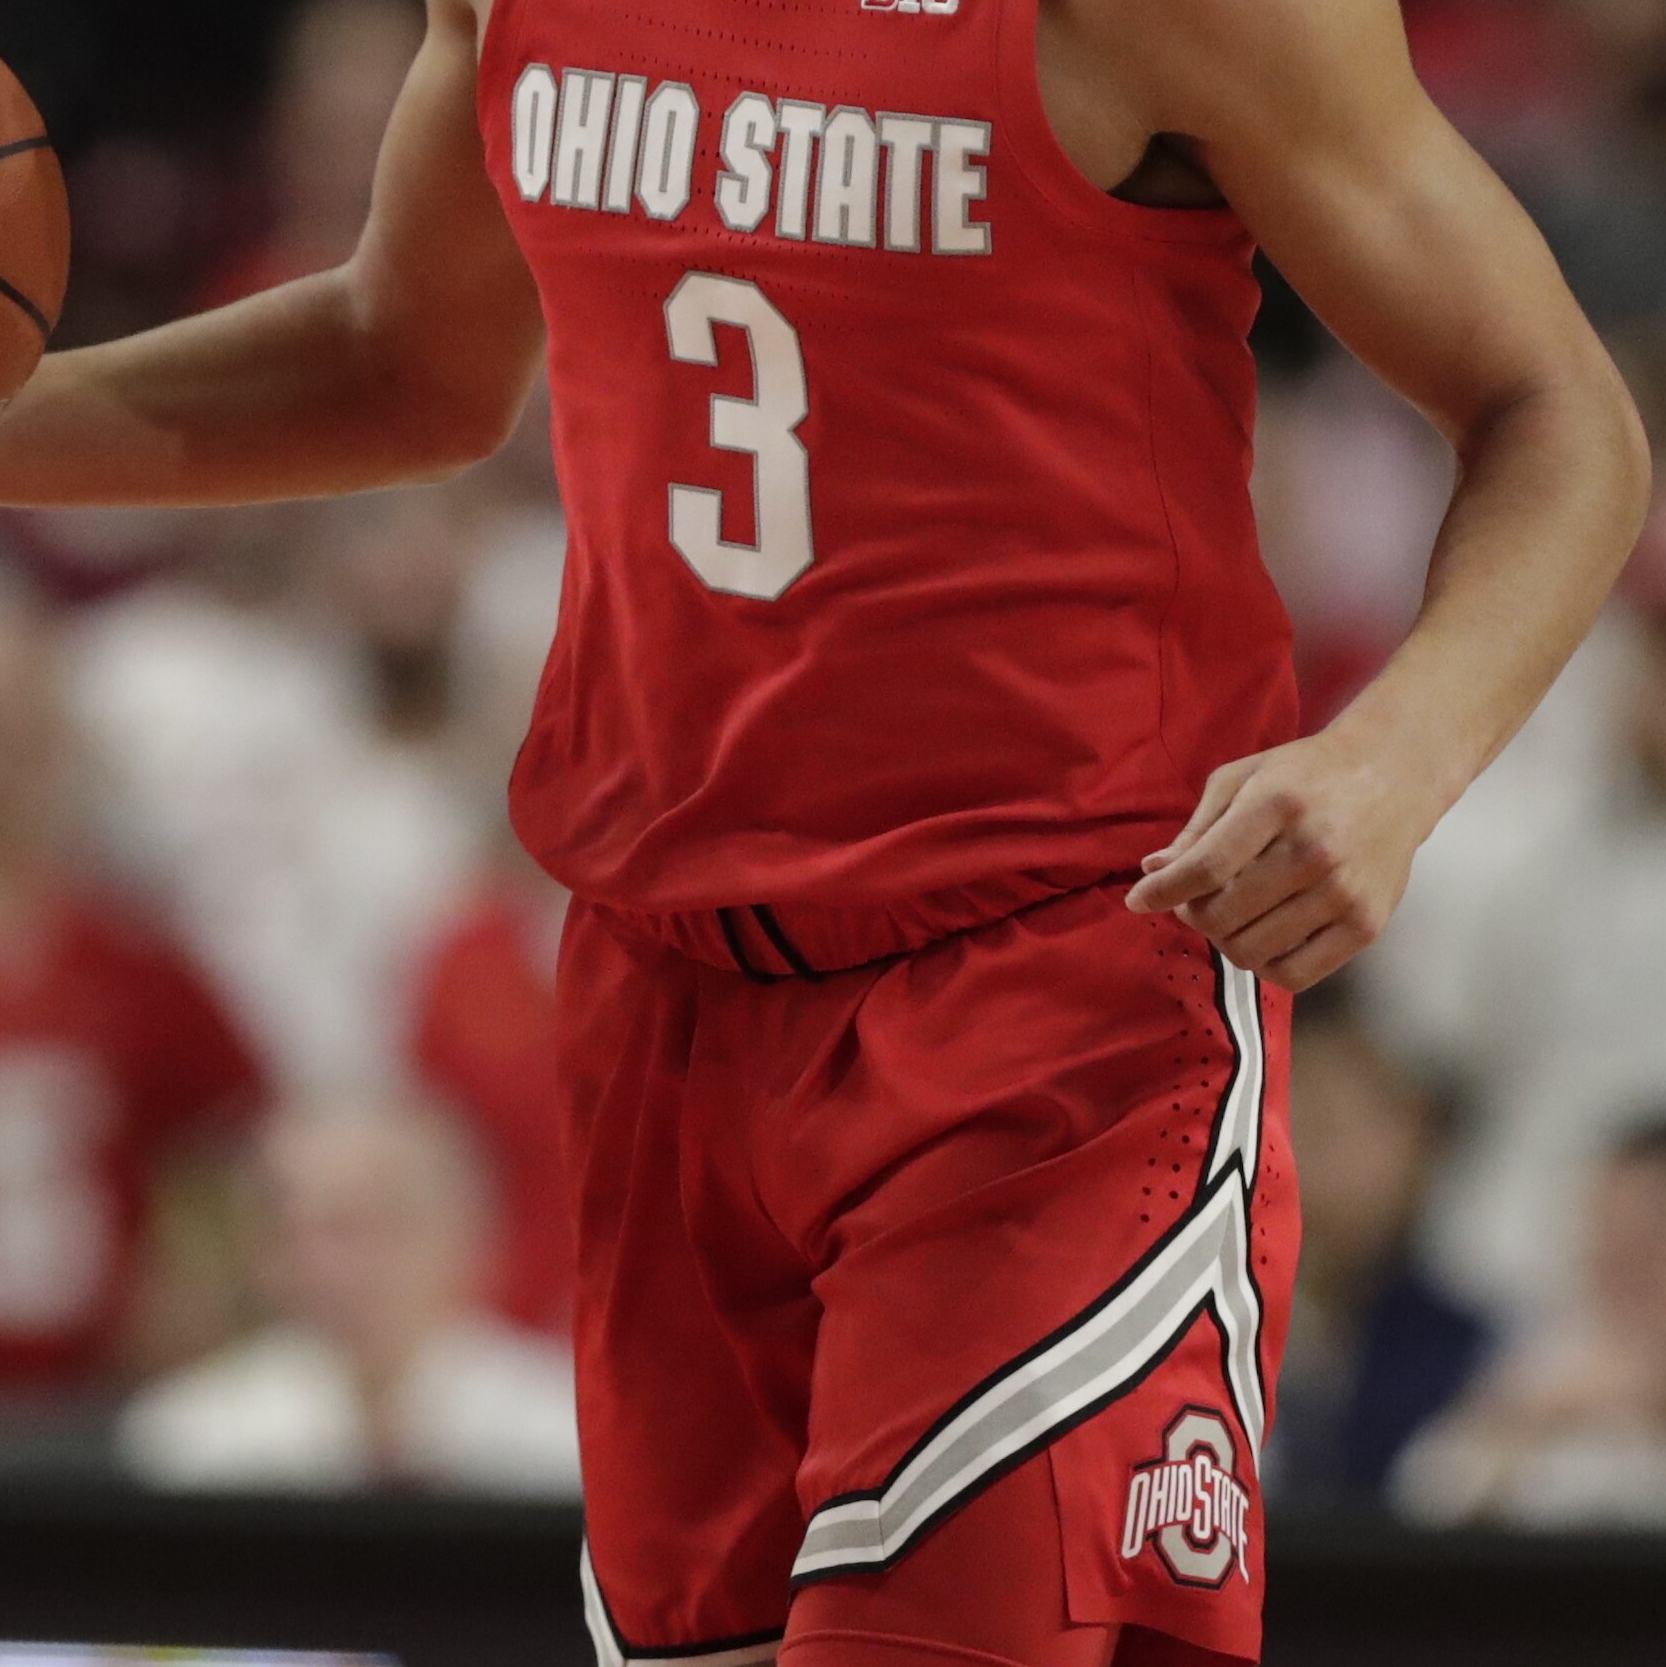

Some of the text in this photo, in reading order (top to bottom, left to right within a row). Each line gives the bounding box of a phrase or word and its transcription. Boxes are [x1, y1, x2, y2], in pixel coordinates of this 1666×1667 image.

[512, 63, 992, 255] OHIO STATE
[663, 271, 815, 601] 3
